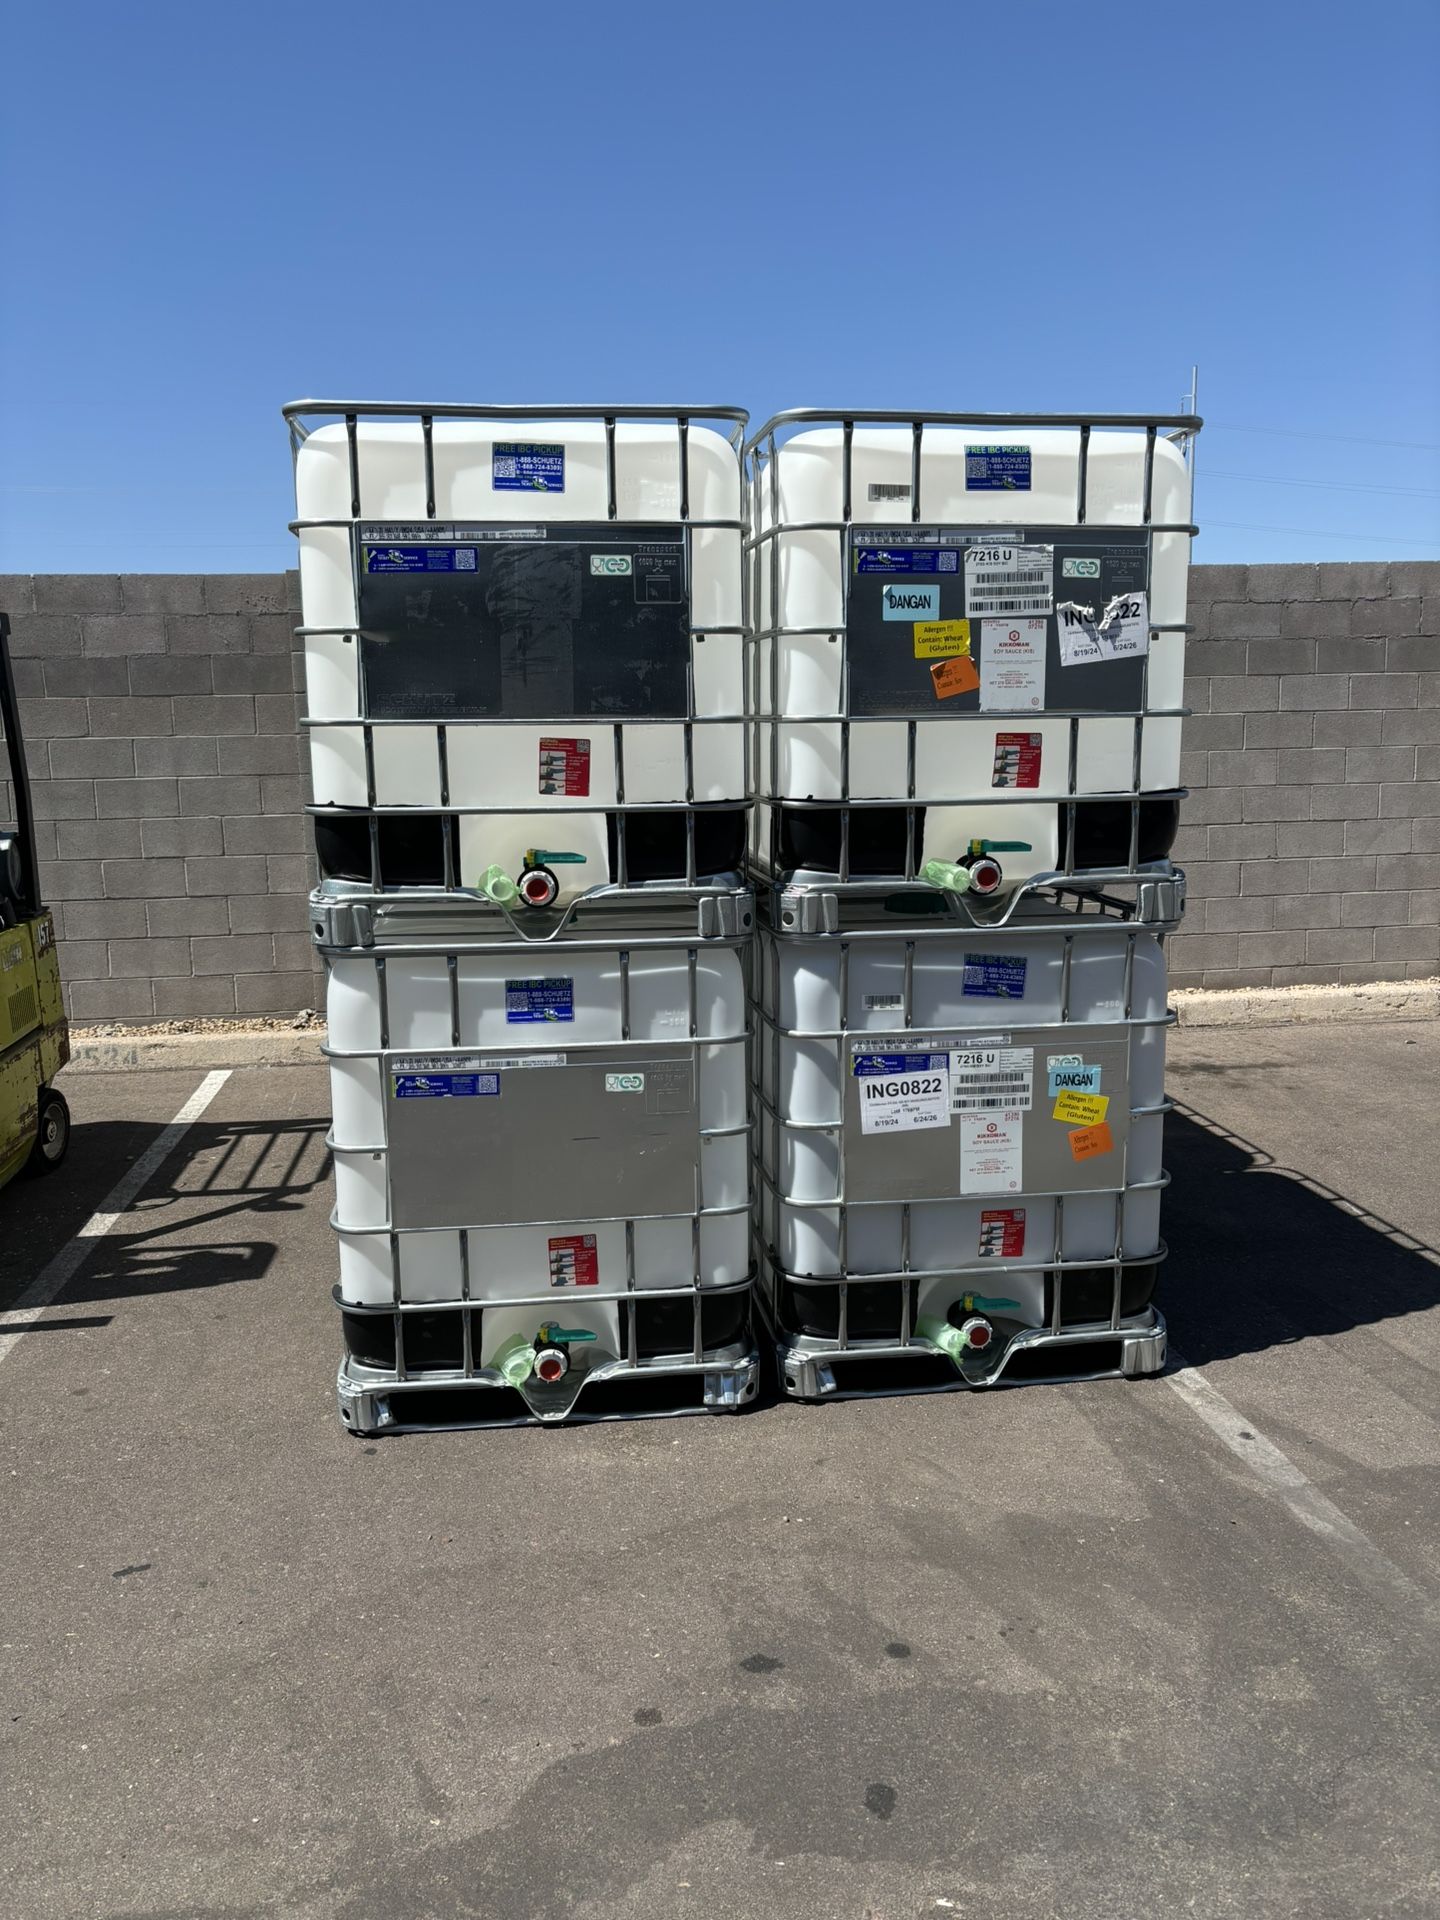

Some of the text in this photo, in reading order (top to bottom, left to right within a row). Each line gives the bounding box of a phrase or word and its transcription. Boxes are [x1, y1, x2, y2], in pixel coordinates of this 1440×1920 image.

[495, 445, 562, 454] FREE IBC PICKUP
[967, 446, 1029, 454] FREE IBC PICKUP
[515, 457, 562, 465] 1-888-SCHUETZ
[972, 550, 1000, 562] 7216
[1003, 550, 1012, 561] U
[889, 594, 931, 609] DANGAN
[923, 626, 946, 634] Allergen
[943, 634, 963, 642] Wheat
[929, 643, 960, 652] (Gluten)
[1073, 648, 1098, 657] 8/19/24
[508, 979, 571, 989] FREE IBC PICKUP
[957, 1054, 983, 1064] 7216
[986, 1053, 995, 1064] U
[1055, 1073, 1093, 1087] DANGAN
[866, 1078, 942, 1099] ING0822
[1066, 1094, 1087, 1103] Allergen
[1082, 1106, 1100, 1114] Wheat
[913, 1114, 937, 1123] 6/24/26
[1066, 1111, 1095, 1122] (Gluten)
